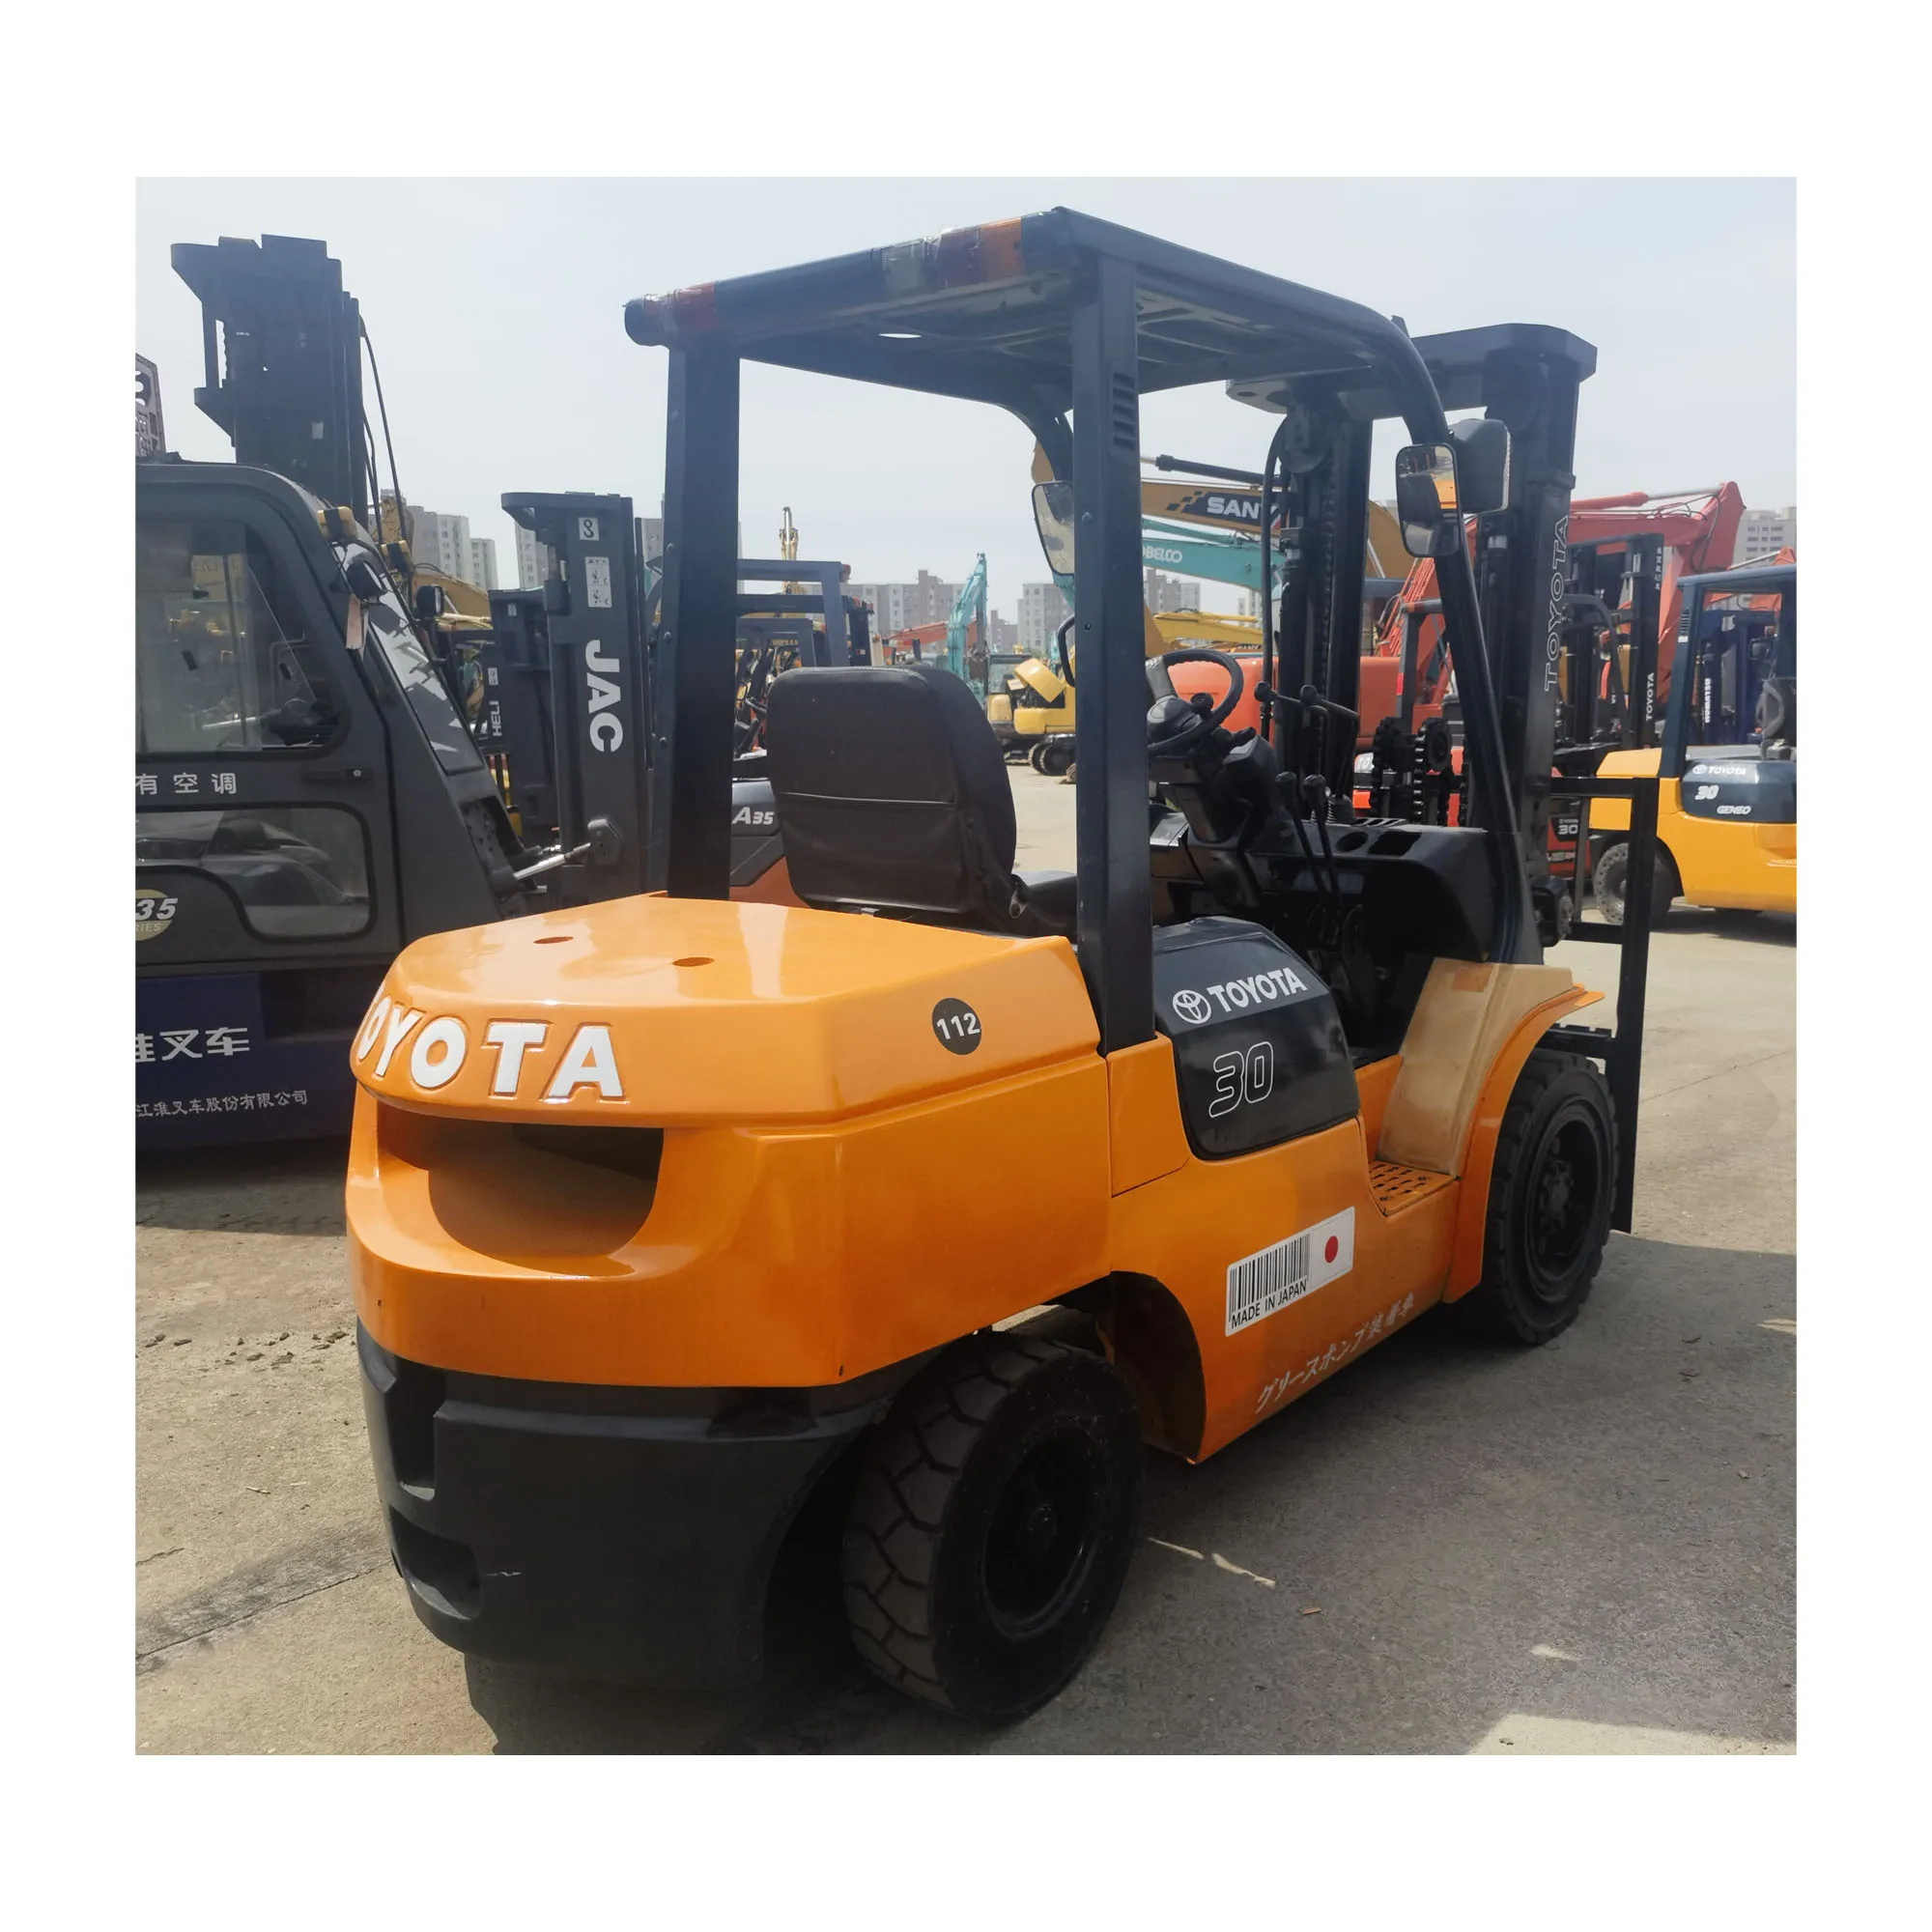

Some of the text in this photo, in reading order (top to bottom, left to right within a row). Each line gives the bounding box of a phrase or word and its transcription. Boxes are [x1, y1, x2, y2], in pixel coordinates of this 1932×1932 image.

[1207, 497, 1277, 520] SAN
[1142, 545, 1183, 563] BELCO
[1545, 515, 1569, 693] TOYOTA
[585, 639, 624, 753] JAC
[1645, 672, 1655, 722] TOYOTA
[489, 700, 502, 736] HELI
[135, 772, 237, 795] 有空调
[1694, 784, 1719, 801] 30
[1558, 824, 1578, 836] 30
[1207, 967, 1308, 1012] TOYOTA
[356, 981, 623, 1097] OYOTA
[936, 1012, 980, 1040] 112
[1208, 1040, 1274, 1119] 30
[1232, 1279, 1307, 1330] MADE IN JAPAN
